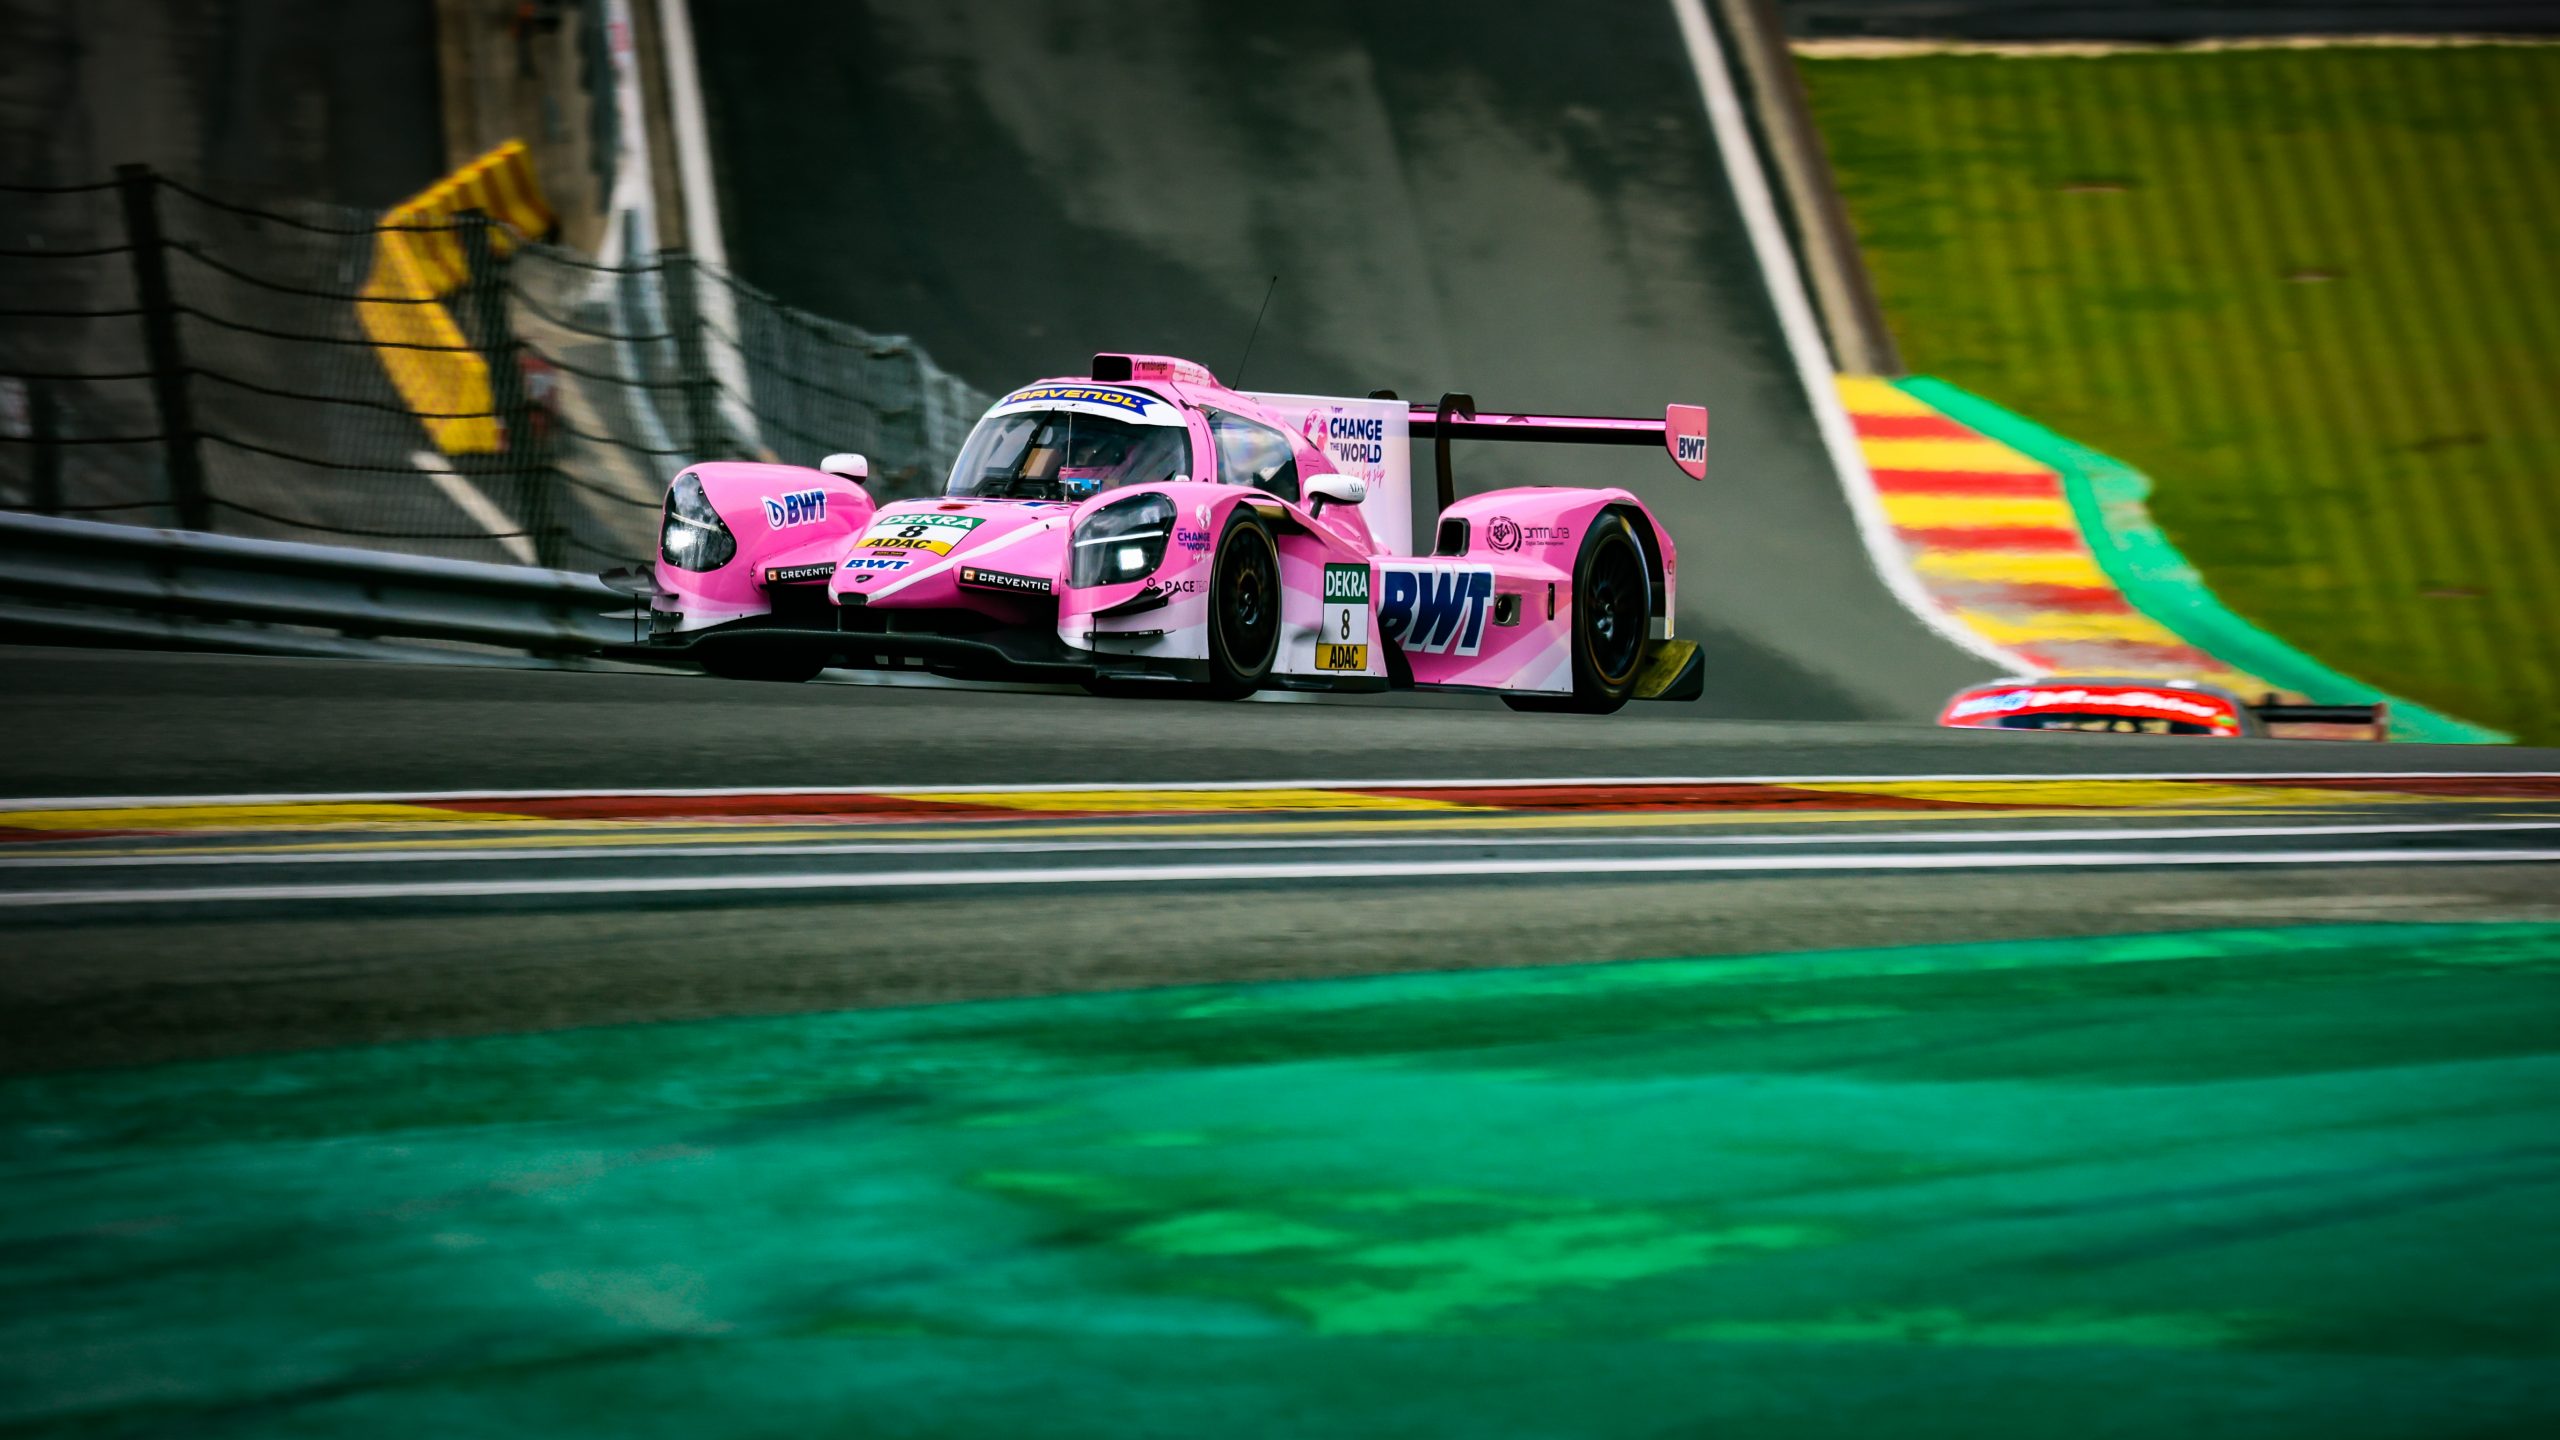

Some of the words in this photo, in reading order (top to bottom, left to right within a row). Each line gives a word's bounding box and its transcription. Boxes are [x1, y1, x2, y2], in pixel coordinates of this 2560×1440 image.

[1010, 387, 1139, 409] RAVENOL
[1330, 417, 1383, 441] CHANGE
[1330, 442, 1340, 451] THE
[1340, 443, 1382, 463] WORLD
[1679, 437, 1705, 460] BWT
[784, 490, 826, 525] BWT
[881, 515, 974, 528] DEKRA
[897, 525, 929, 538] 8
[865, 538, 932, 549] ADAC
[780, 566, 835, 579] CREVENTIC
[845, 560, 911, 570] BWT
[979, 572, 1050, 591] CREVENTIC
[1325, 571, 1368, 597] DEKRA
[1378, 571, 1492, 648] BWT
[1341, 609, 1350, 640] 8
[1329, 646, 1358, 669] ADAC
